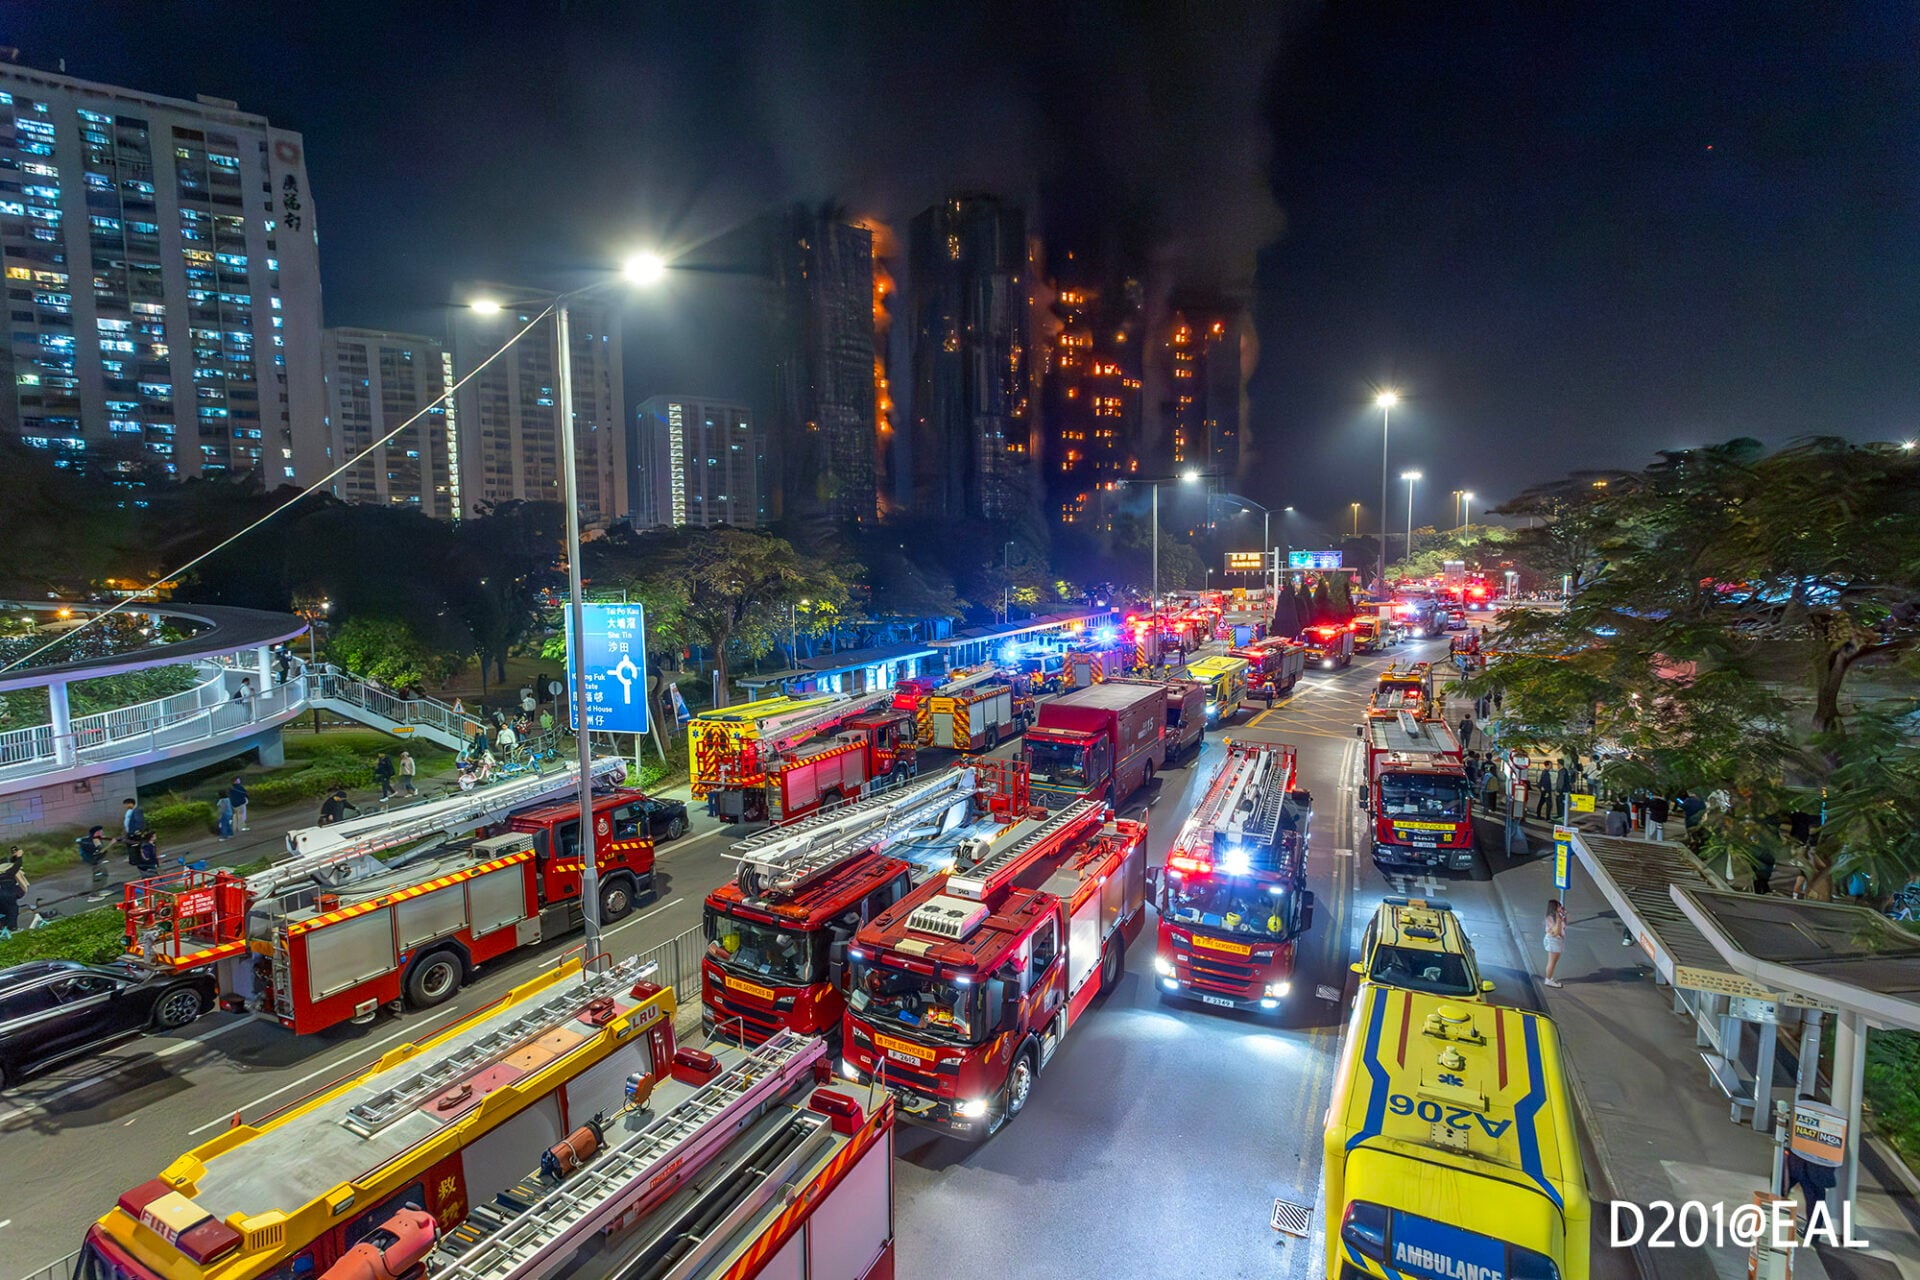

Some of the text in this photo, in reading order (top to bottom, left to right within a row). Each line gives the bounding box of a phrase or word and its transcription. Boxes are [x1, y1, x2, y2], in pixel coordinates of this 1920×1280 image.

[606, 607, 639, 615] Tai Po Kau
[607, 631, 633, 639] Sha Tin
[608, 641, 629, 653] 沙田
[571, 672, 606, 681] Kng Fuk
[592, 705, 613, 713] House
[632, 1006, 656, 1029] LRU
[884, 1038, 925, 1057] FIRE SERVICES
[1389, 1094, 1512, 1138] A206
[1820, 1132, 1841, 1145] N42A
[141, 1210, 178, 1244] FIRE
[1395, 1241, 1502, 1280] AMBULANCE
